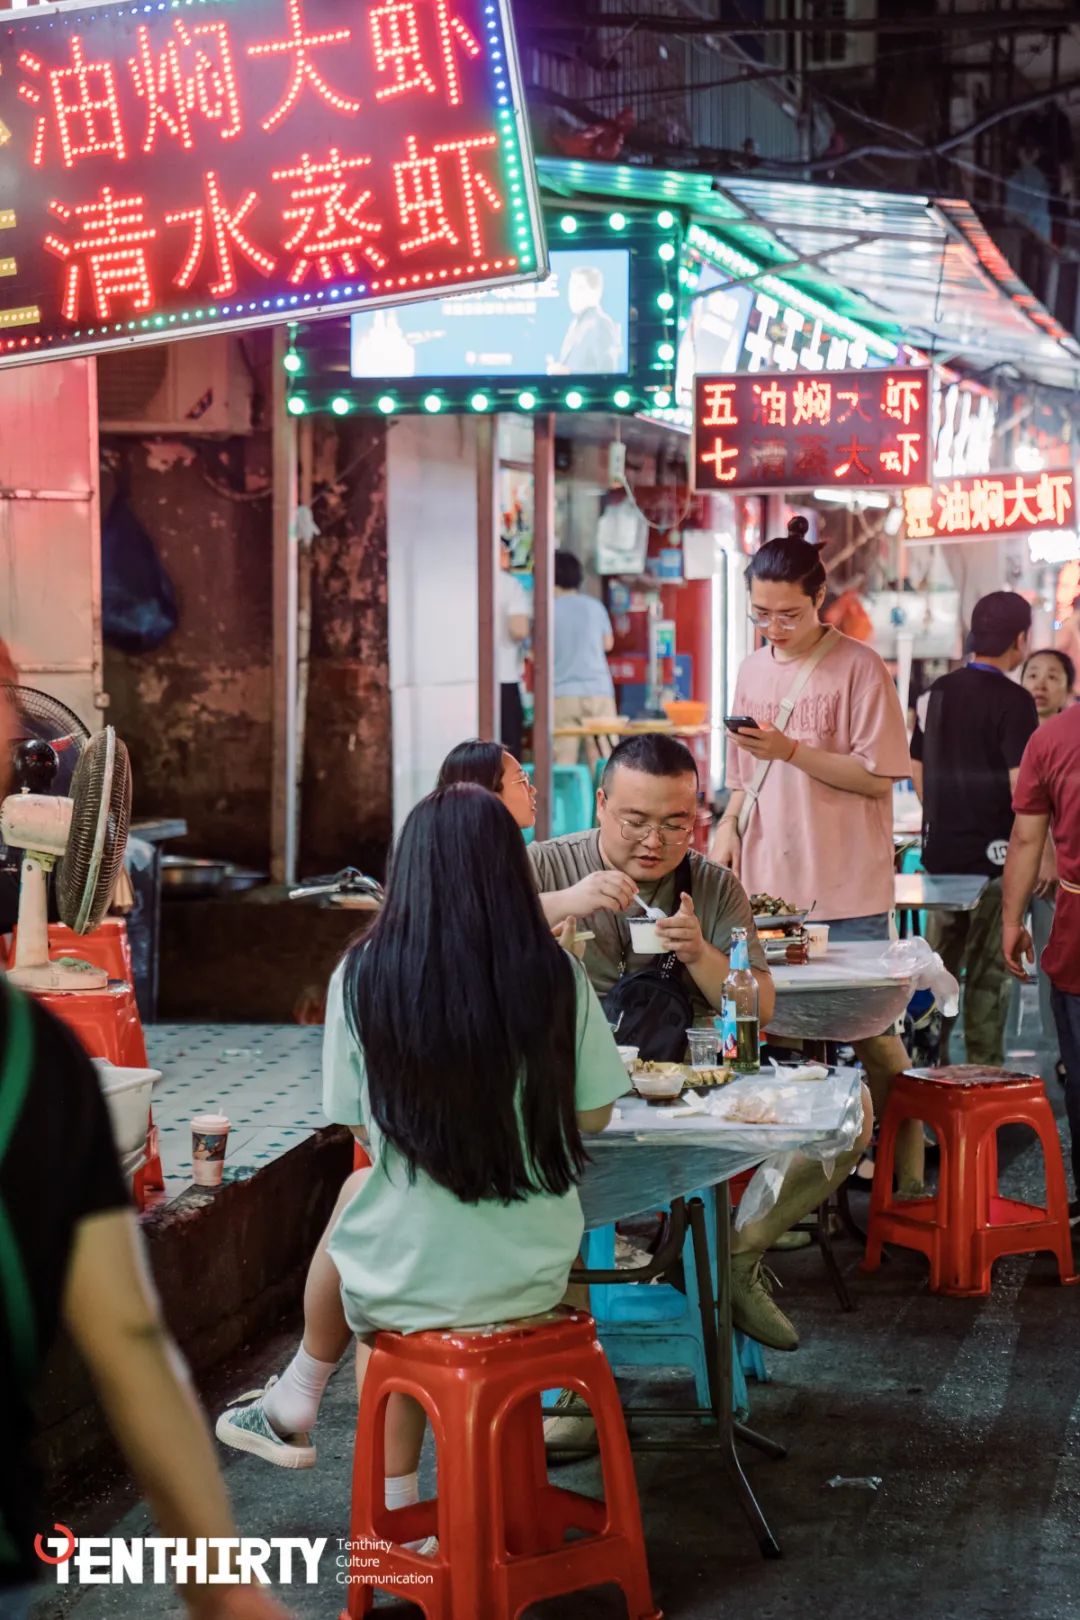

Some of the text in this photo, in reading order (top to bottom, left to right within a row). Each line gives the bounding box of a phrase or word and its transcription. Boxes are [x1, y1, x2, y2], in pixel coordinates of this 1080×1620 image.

[17, 0, 483, 168] 油焖大虾
[43, 136, 504, 322] 清水蒸虾
[936, 473, 1073, 533] 油焖大虾
